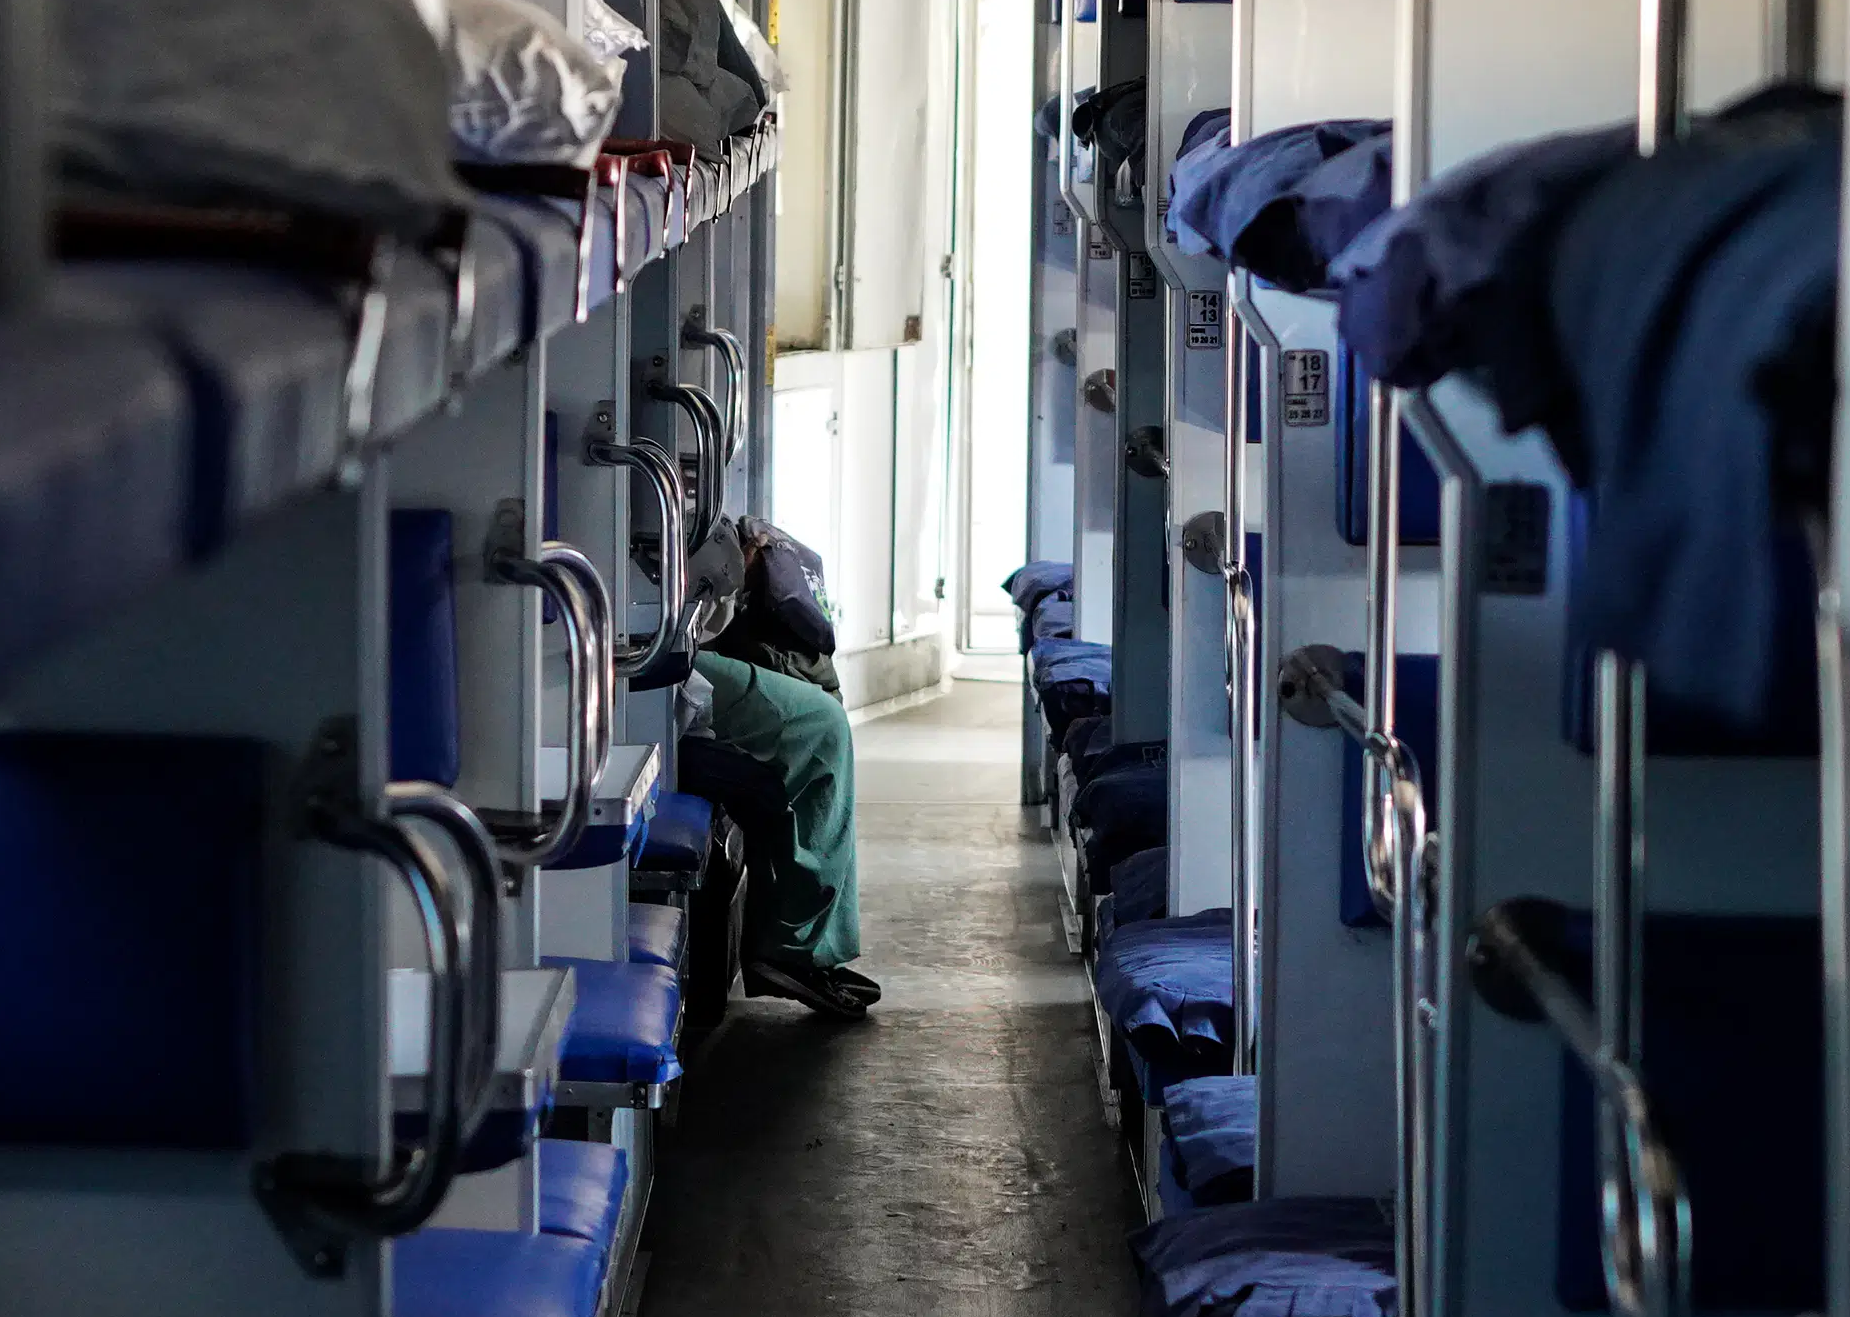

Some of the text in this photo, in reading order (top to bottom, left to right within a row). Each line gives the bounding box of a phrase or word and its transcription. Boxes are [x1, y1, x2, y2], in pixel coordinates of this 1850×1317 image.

[1200, 294, 1218, 308] 14
[1200, 309, 1217, 322] 13
[1299, 354, 1321, 371] 18
[1299, 373, 1321, 390] 17
